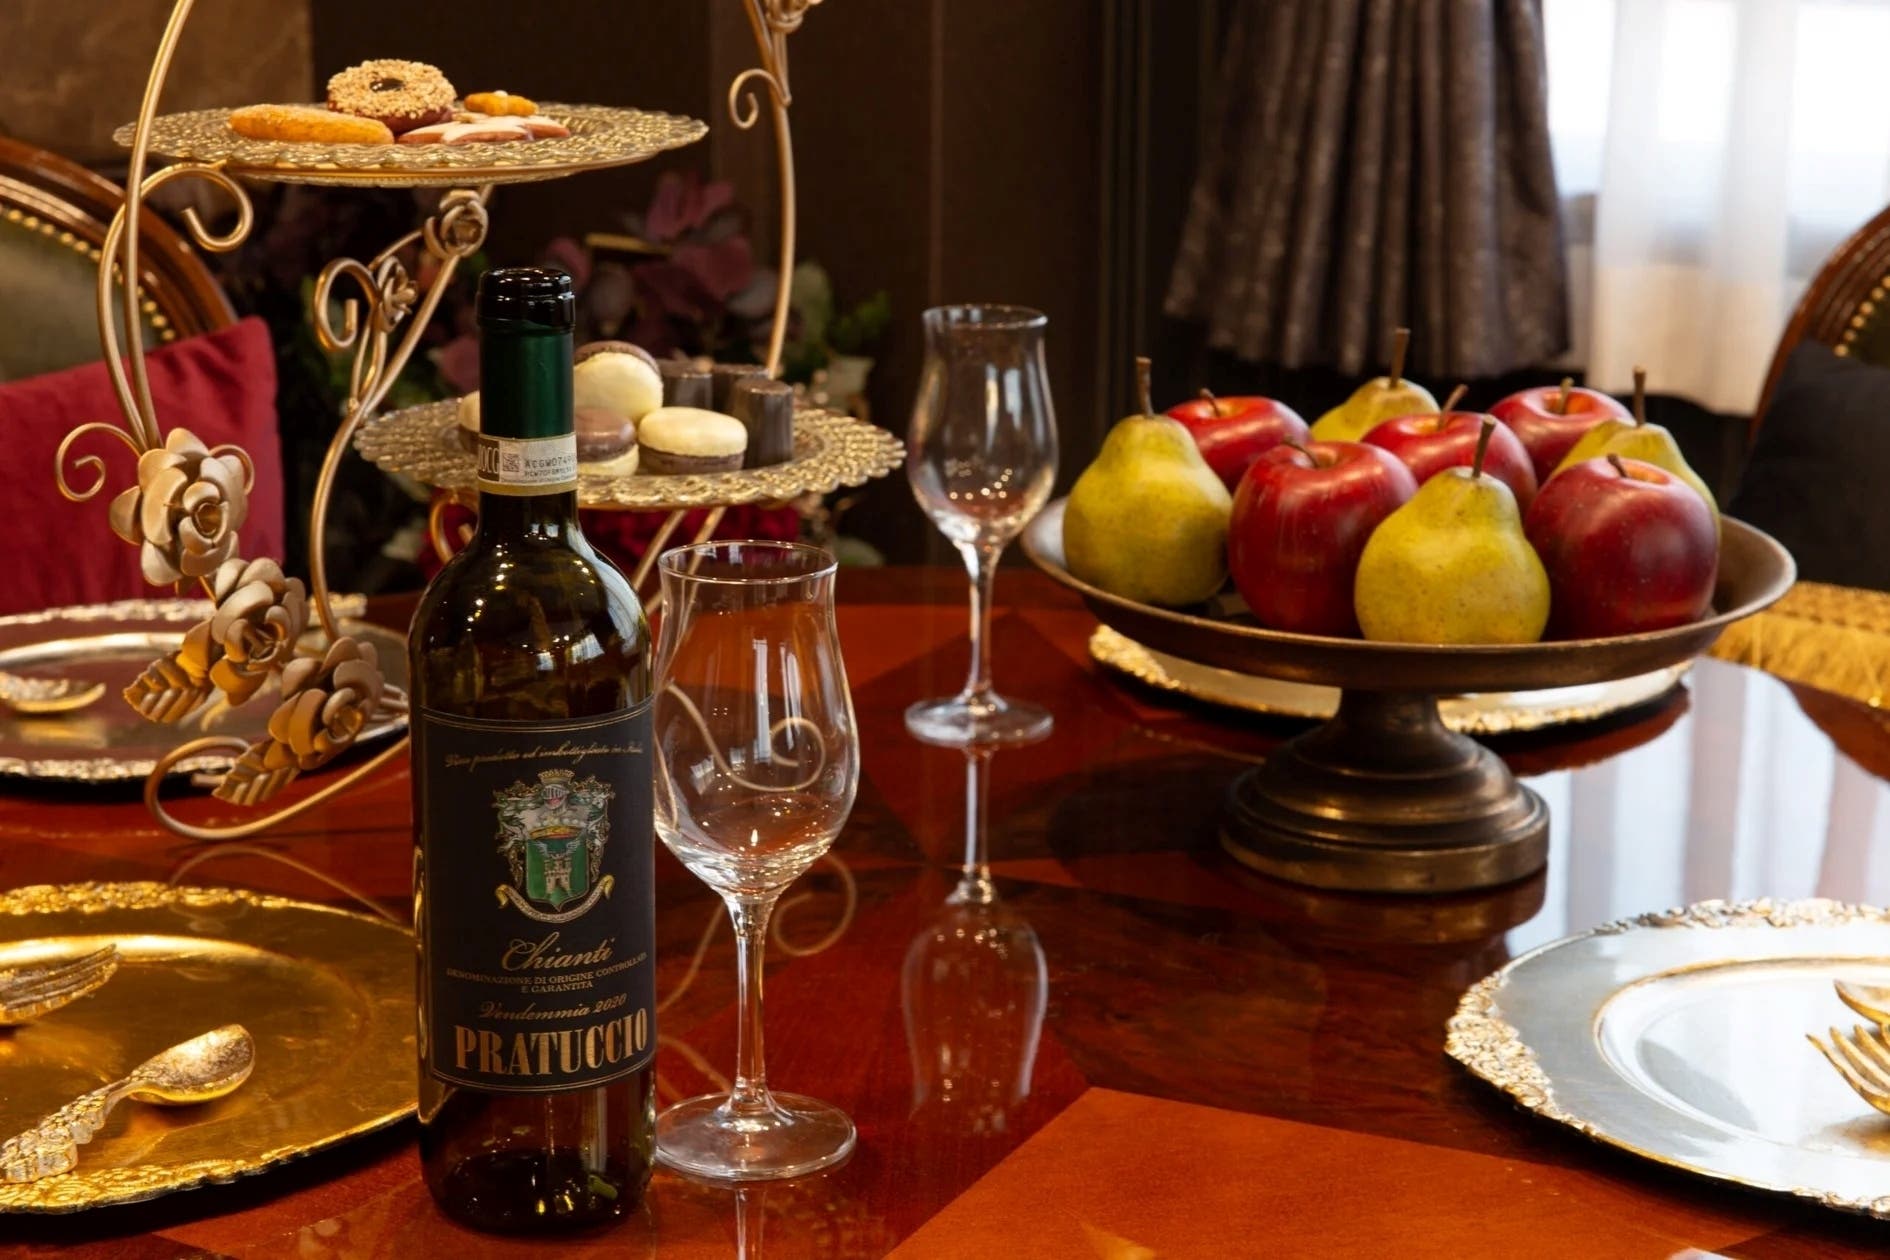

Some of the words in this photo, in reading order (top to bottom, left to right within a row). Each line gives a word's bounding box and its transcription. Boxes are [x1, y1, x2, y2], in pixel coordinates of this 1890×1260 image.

[501, 931, 616, 972] Chianti
[446, 967, 532, 986] DENOMINAZIONE
[534, 976, 548, 986] DI
[549, 971, 594, 985] ORIGINE
[521, 985, 529, 994] E
[531, 980, 593, 994] GARANTITA
[480, 1001, 591, 1021] Vendemmia
[593, 993, 628, 1014] 2020
[454, 1007, 648, 1076] PRATUCCIO
